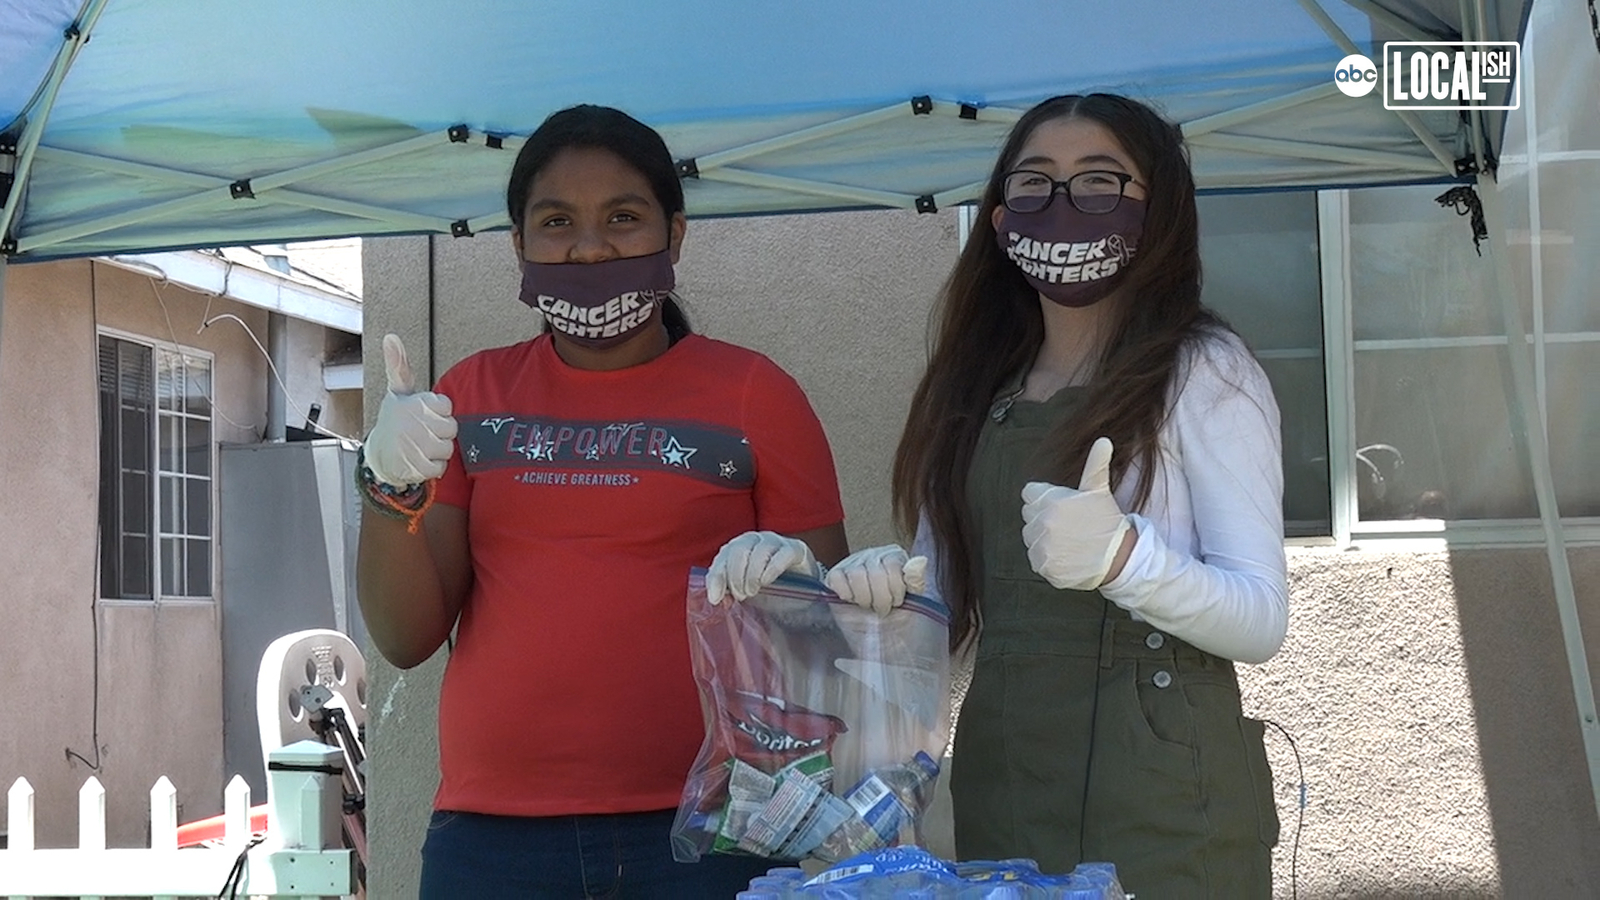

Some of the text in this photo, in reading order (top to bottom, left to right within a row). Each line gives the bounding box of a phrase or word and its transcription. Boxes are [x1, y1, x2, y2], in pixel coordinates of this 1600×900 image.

[1007, 245, 1121, 284] GHTERS
[533, 301, 654, 339] GHTERS
[537, 291, 641, 326] CANCER
[506, 422, 668, 457] EMPOWER
[522, 471, 631, 486] ACHIEVE GREATNESS
